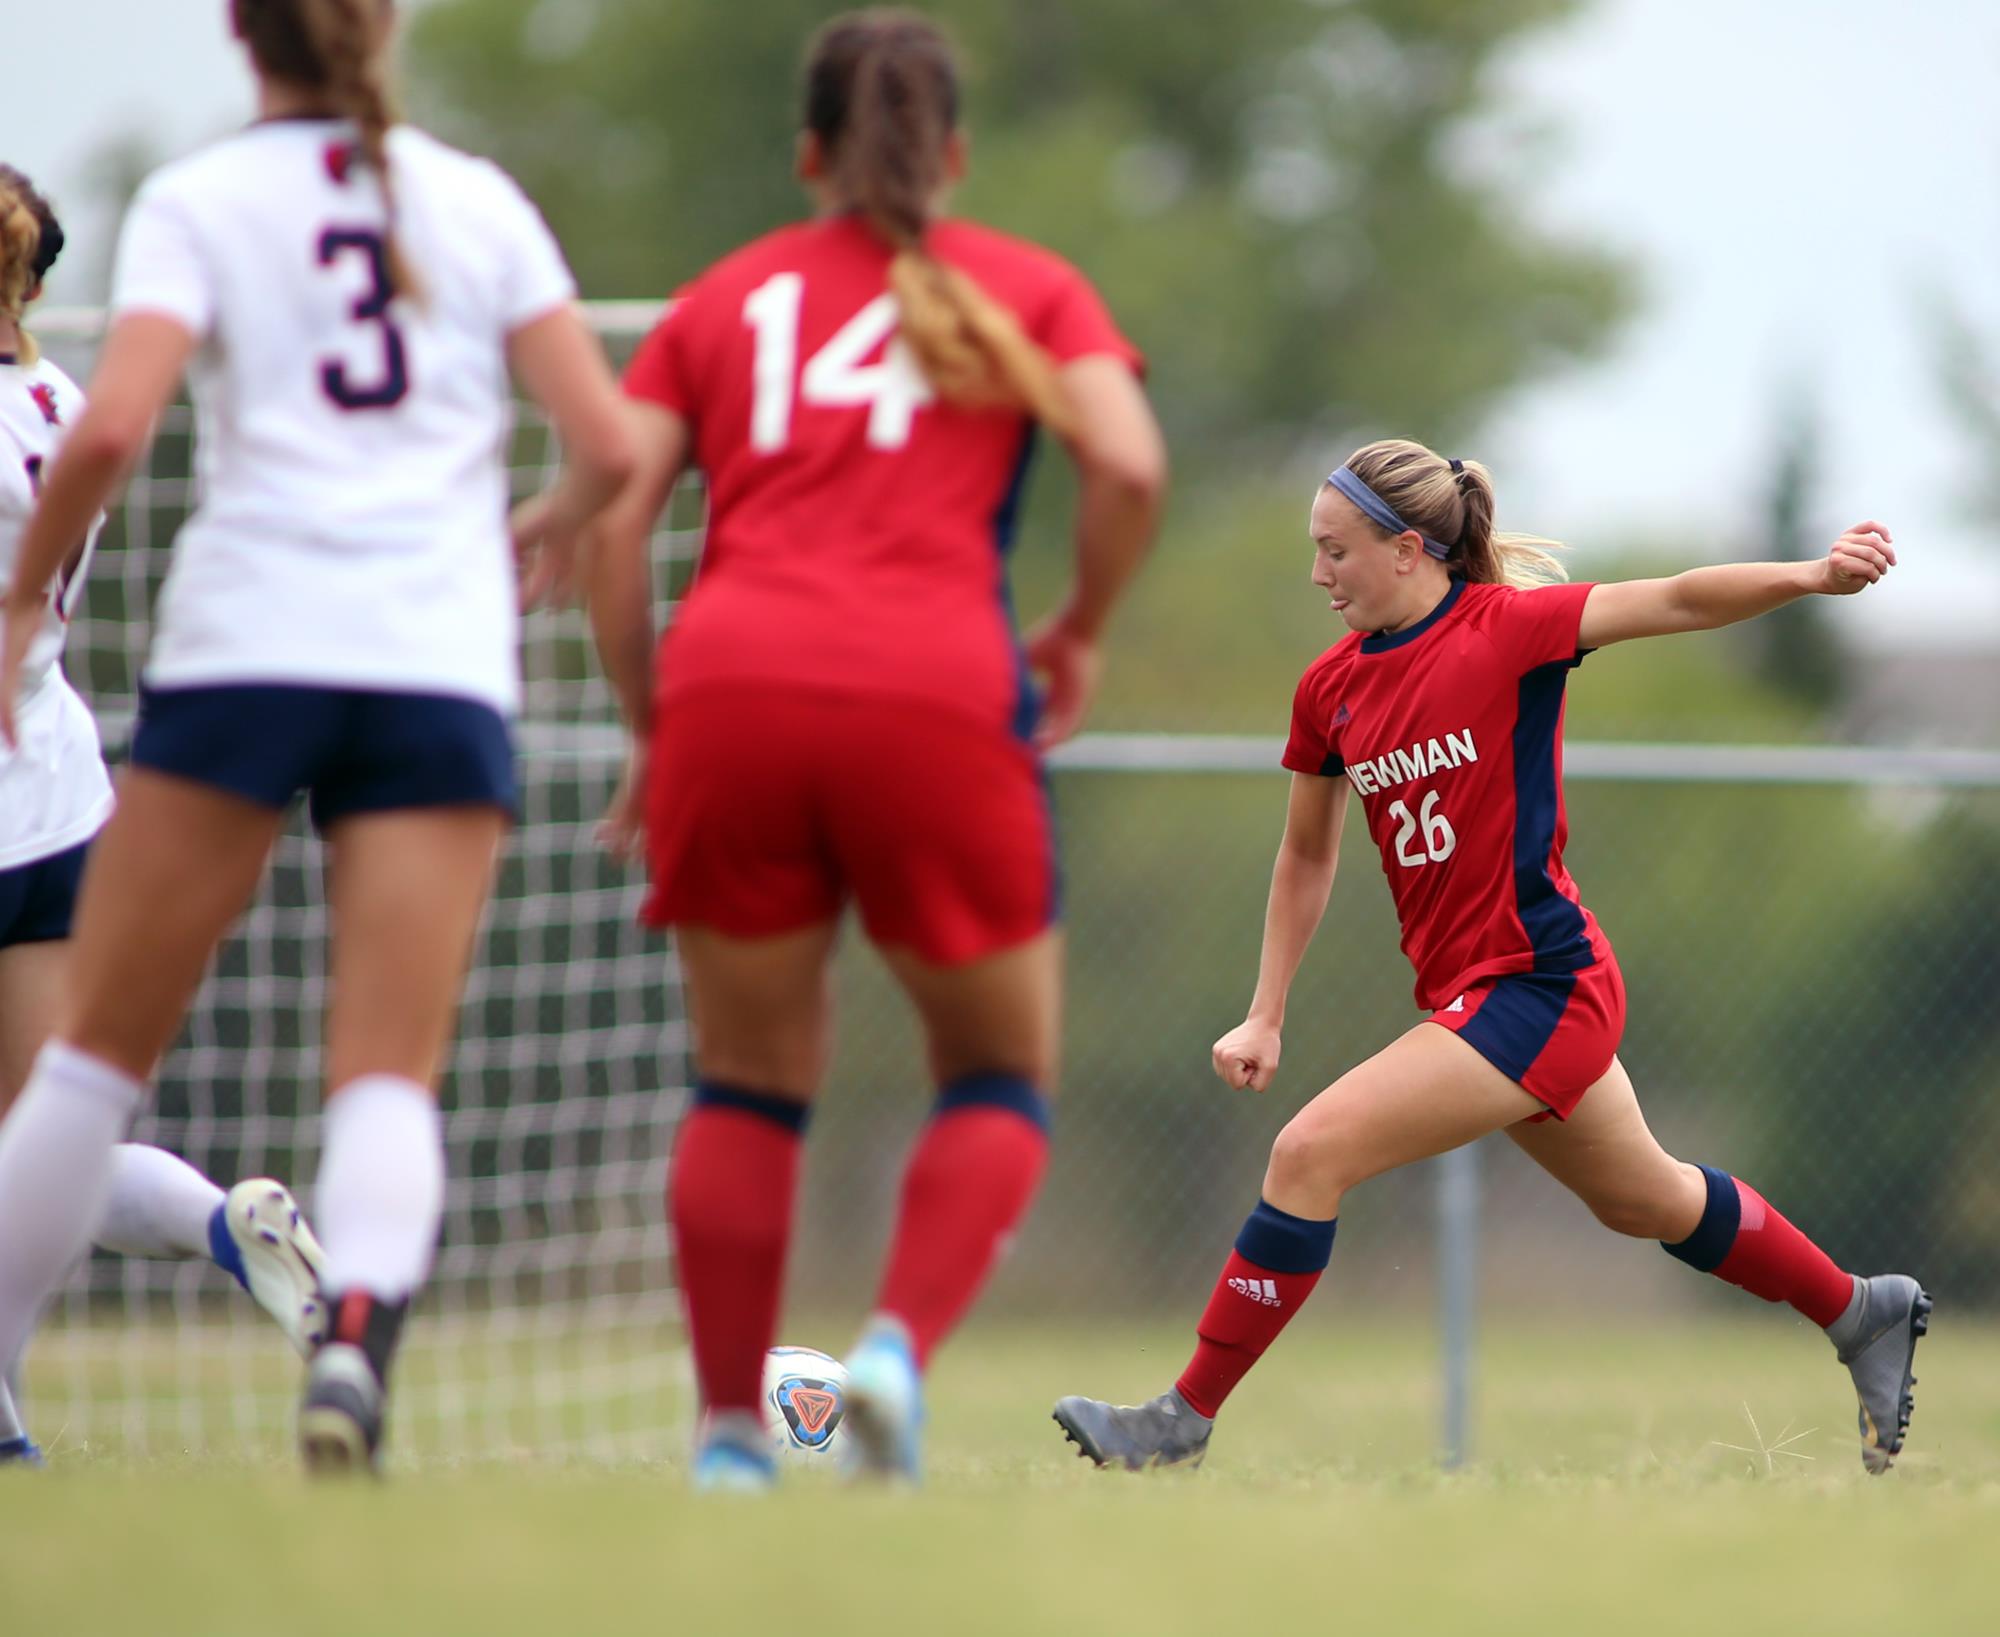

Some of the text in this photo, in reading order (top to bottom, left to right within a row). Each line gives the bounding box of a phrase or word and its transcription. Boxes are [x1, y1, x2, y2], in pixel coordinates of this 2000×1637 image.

[317, 226, 409, 408] 3
[742, 271, 932, 454] 14
[1345, 728, 1478, 796] NEWMAN
[1388, 789, 1456, 867] 26
[1227, 1277, 1282, 1308] adidas
